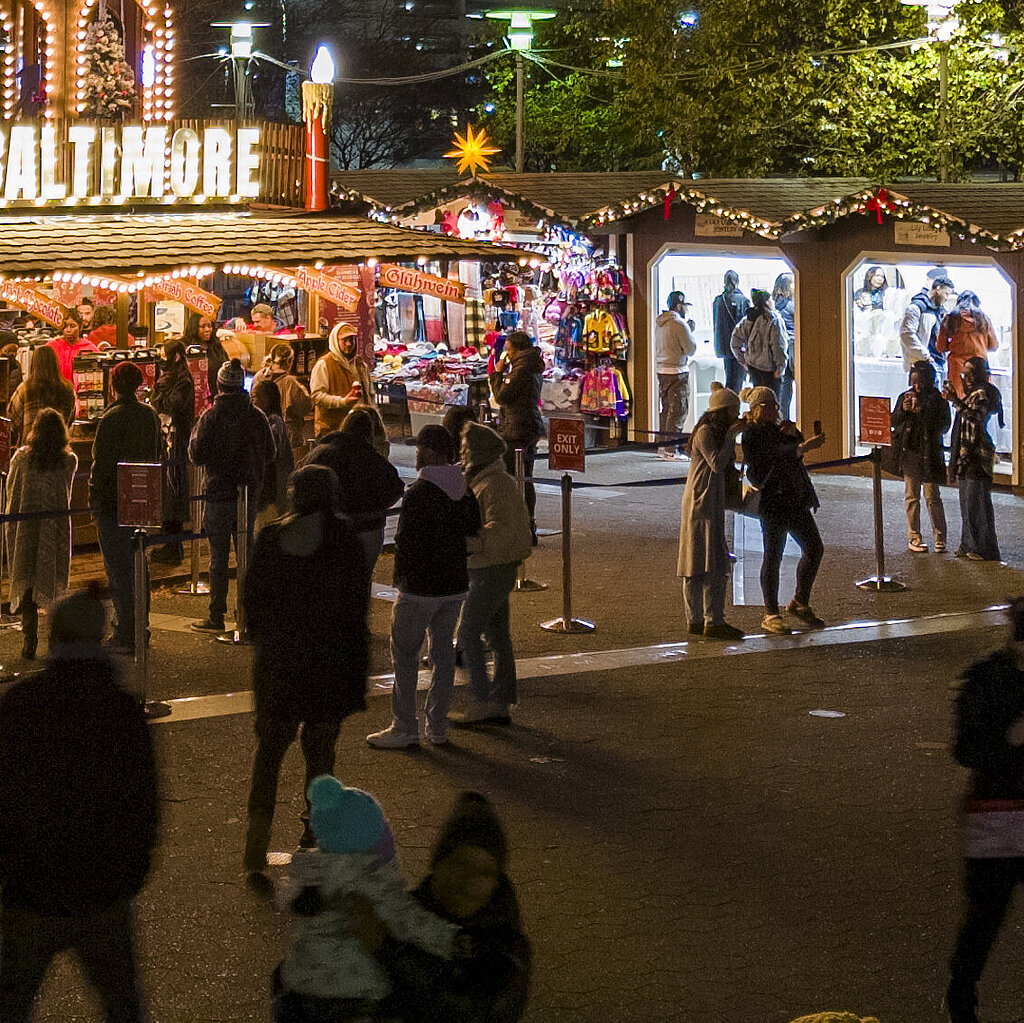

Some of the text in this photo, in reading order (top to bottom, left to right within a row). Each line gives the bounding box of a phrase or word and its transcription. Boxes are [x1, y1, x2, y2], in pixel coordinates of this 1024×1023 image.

[297, 270, 326, 292] Apple
[328, 281, 356, 306] Cider
[385, 267, 459, 299] Glühwein
[184, 287, 214, 316] Coffee
[553, 443, 580, 455] ONLY
[557, 433, 577, 444] EXIT
